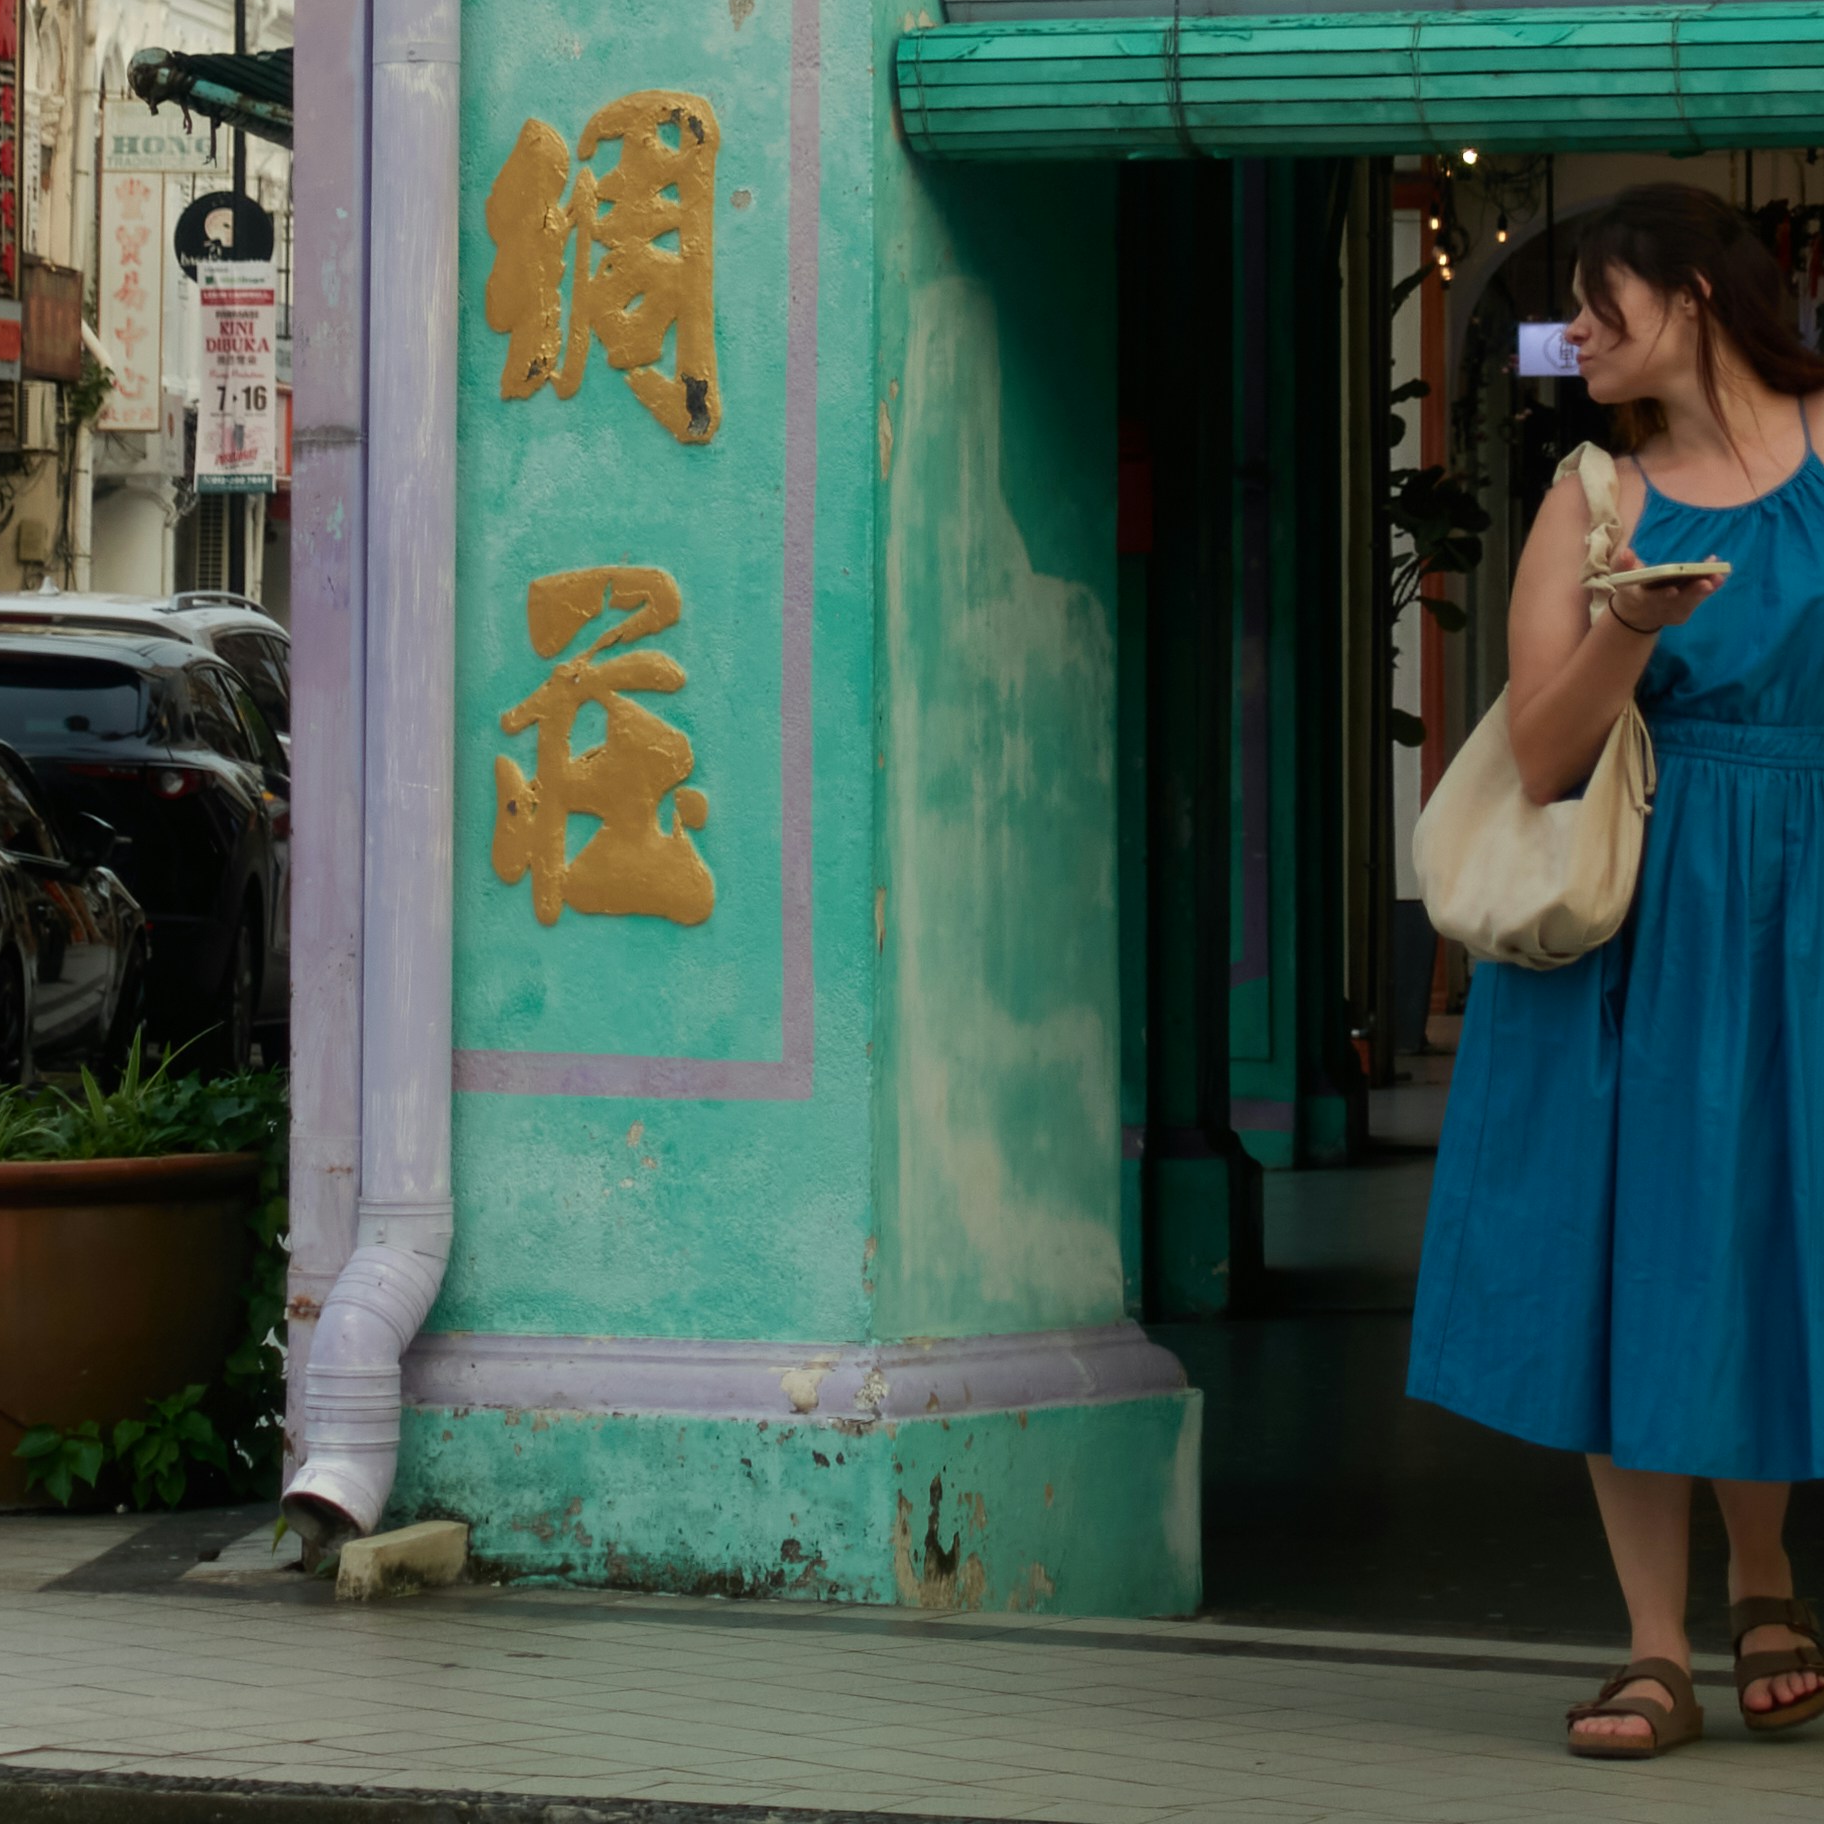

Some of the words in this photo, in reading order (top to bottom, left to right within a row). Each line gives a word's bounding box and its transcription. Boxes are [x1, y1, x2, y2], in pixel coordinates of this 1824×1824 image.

[219, 321, 255, 336] KINI
[205, 337, 271, 353] DIBUKA
[243, 385, 267, 412] 16
